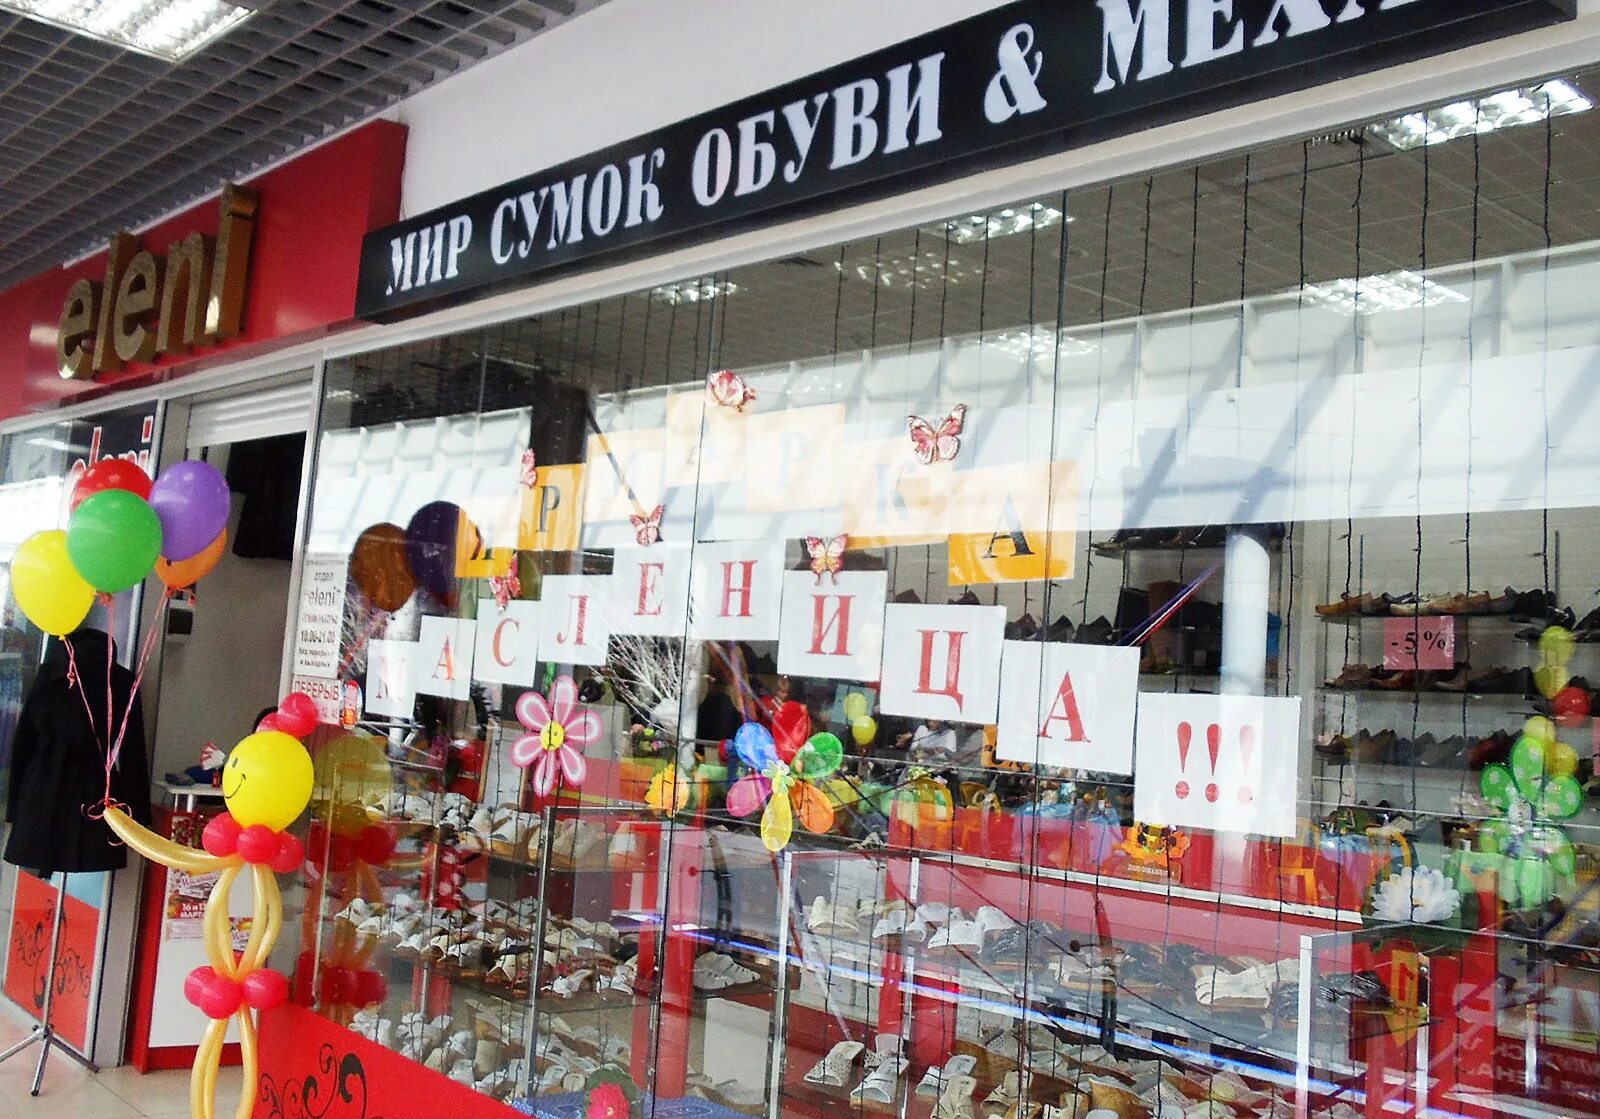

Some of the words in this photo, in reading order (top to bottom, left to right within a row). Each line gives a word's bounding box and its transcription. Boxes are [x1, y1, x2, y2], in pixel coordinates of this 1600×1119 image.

[386, 215, 472, 295] МИР
[491, 147, 666, 265] СУМОК
[691, 52, 945, 207] ОБУВИ
[984, 22, 1048, 124] &
[1093, 0, 1418, 93] МЕХ
[58, 183, 257, 380] eleni
